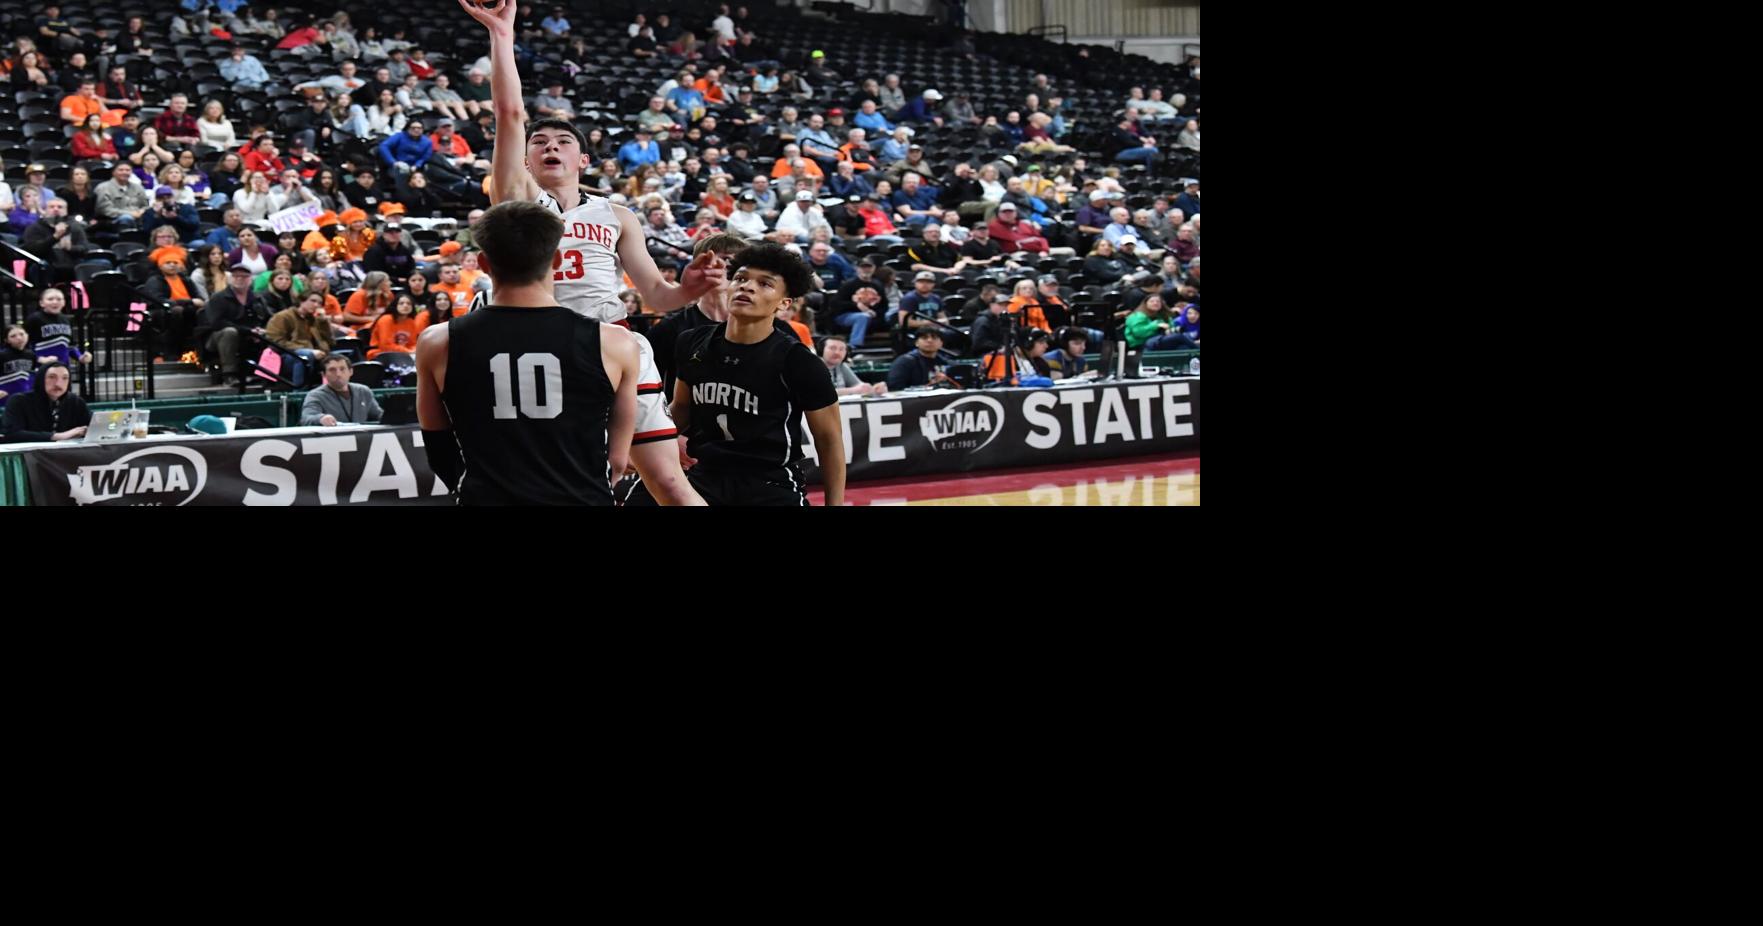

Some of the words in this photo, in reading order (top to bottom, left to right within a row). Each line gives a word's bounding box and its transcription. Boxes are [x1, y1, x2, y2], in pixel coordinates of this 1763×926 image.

[489, 352, 563, 419] 10
[692, 382, 759, 415] NORTH
[716, 413, 735, 441] 1
[932, 409, 992, 434] WIAA
[1022, 382, 1195, 449] STATE
[91, 464, 190, 496] WIAA
